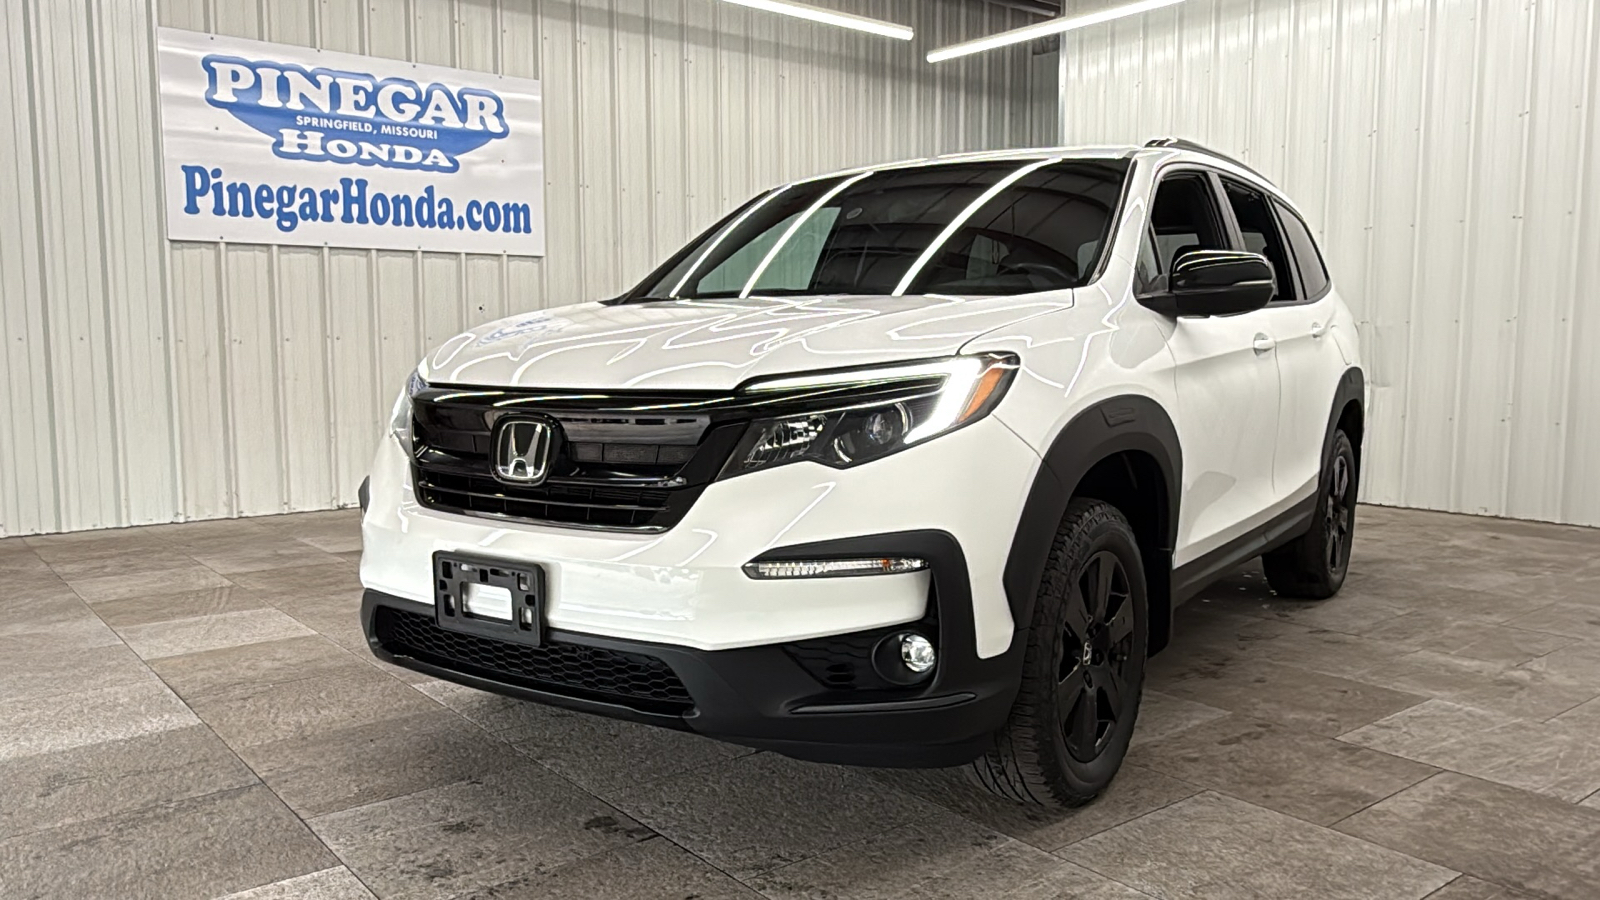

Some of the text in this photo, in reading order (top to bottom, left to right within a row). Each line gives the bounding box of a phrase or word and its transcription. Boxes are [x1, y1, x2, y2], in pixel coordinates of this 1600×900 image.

[209, 61, 504, 134] PINEGAR
[279, 128, 454, 168] HONDA
[296, 115, 438, 140] SPRINGFIELD, MISSOURI
[181, 164, 533, 234] PinegarHonda.com
